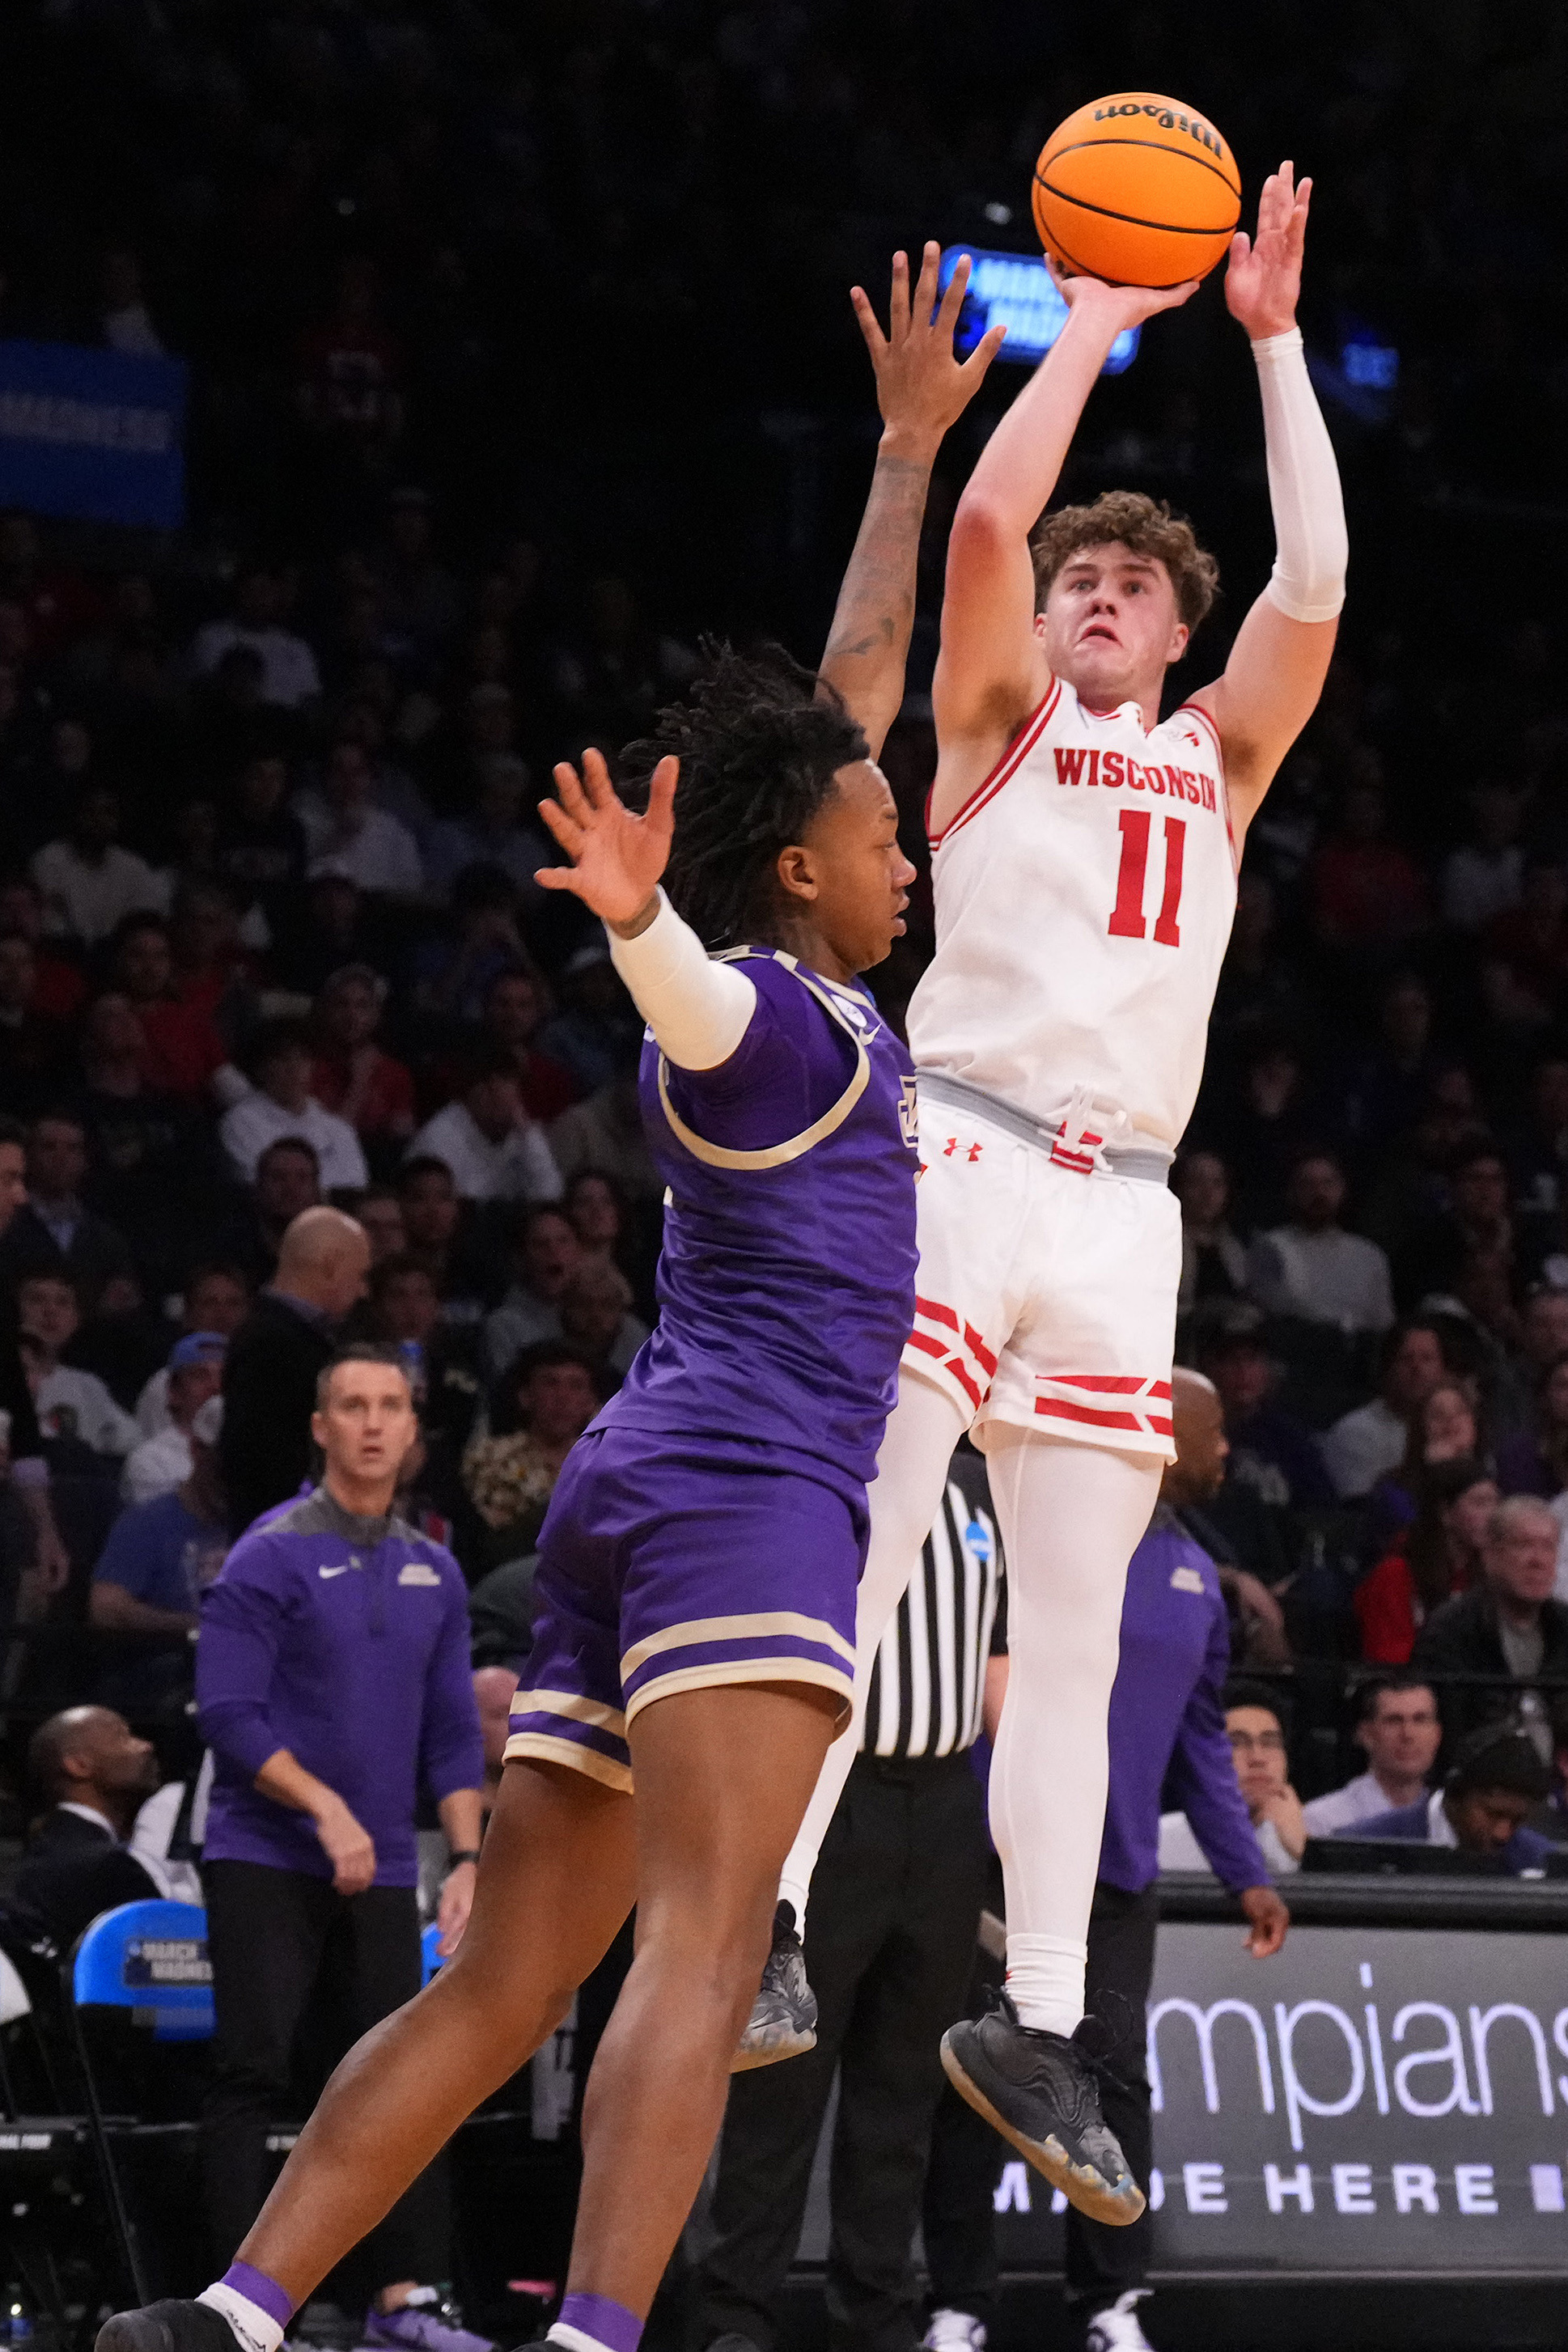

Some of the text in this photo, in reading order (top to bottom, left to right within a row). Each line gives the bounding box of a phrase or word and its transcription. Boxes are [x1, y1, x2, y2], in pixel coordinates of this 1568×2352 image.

[1093, 103, 1223, 161] Wilson
[1053, 748, 1218, 814] WISCONSIN
[1107, 809, 1187, 948] 11
[1263, 2162, 1499, 2214] HERE
